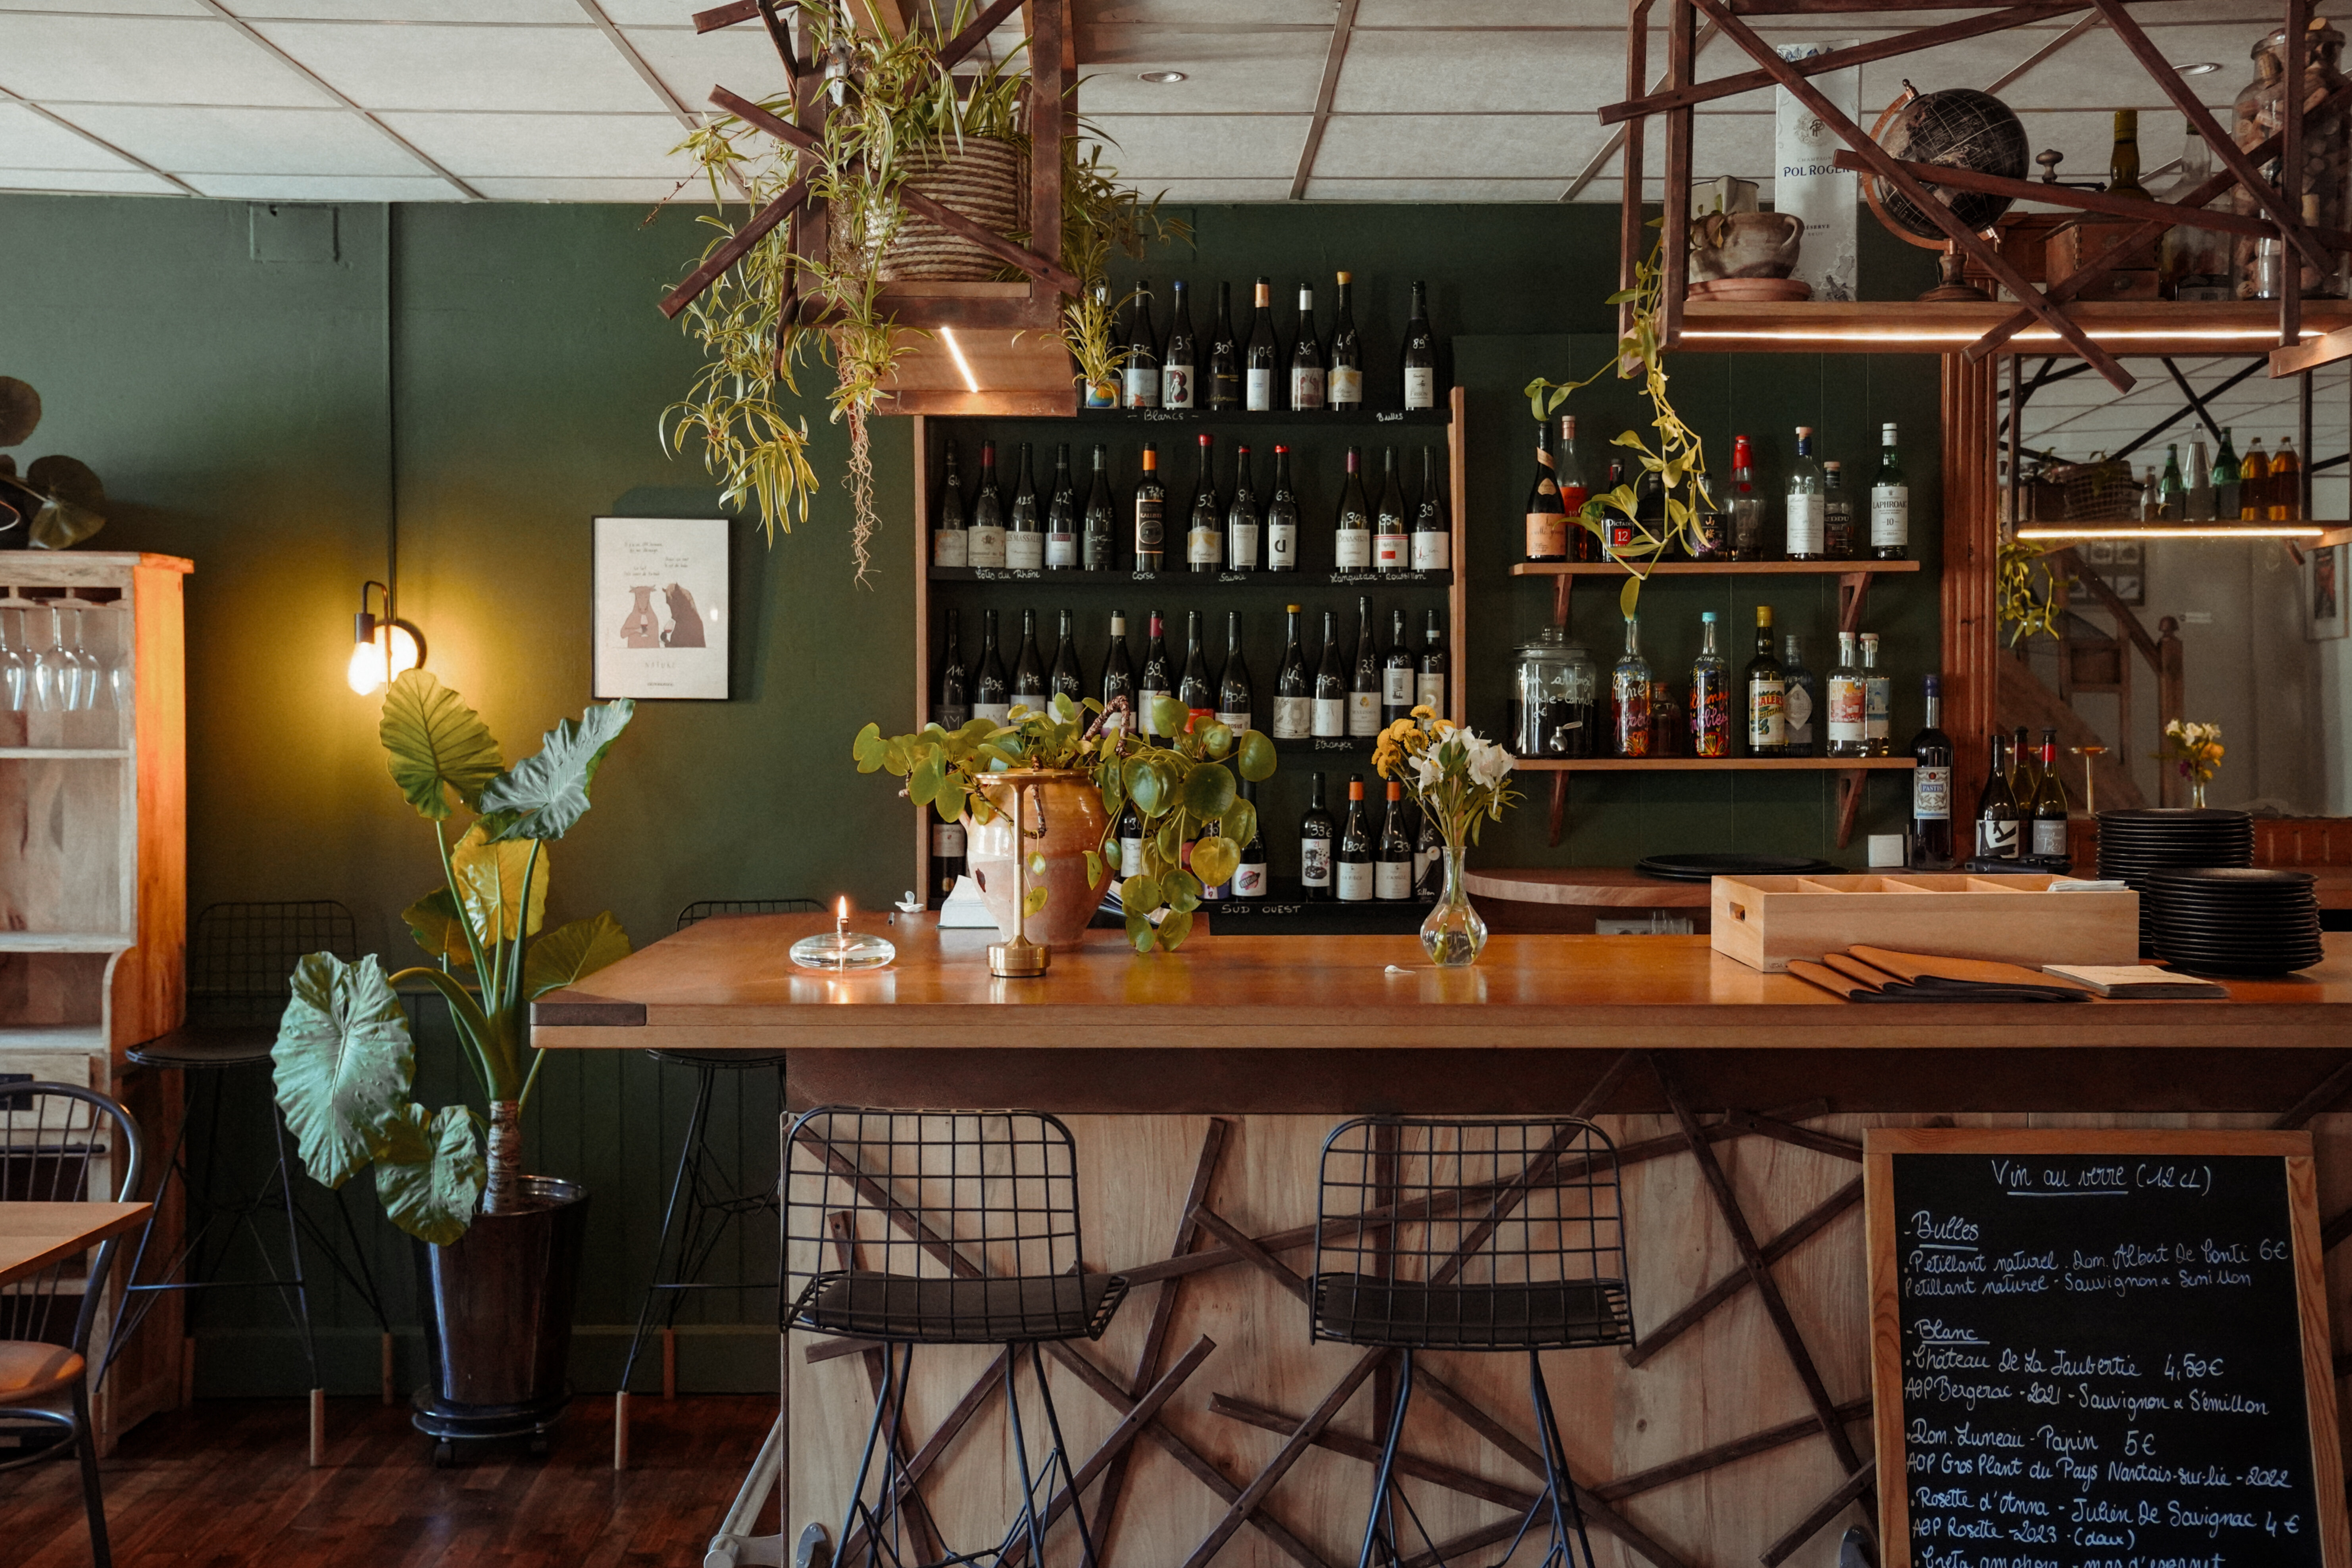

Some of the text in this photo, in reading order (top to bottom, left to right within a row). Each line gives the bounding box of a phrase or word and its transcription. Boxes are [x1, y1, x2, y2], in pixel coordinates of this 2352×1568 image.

[1784, 167, 1807, 177] POL
[1413, 334, 1429, 349] 89€
[1144, 410, 1184, 421] Blancs
[1376, 412, 1403, 422] Bulles
[1056, 488, 1073, 506] 42€
[1873, 500, 1907, 509] LAPHROAIG
[1618, 531, 1628, 541] 12
[975, 569, 995, 580] Côtes
[1013, 569, 1040, 579] Rhône
[1132, 571, 1155, 580] Corse
[1311, 825, 1333, 837] 33€
[1221, 904, 1301, 914] SUD OUEST
[1992, 1160, 2032, 1187] Vin
[2044, 1169, 2070, 1187] au
[2078, 1166, 2128, 1186] verre
[1911, 1210, 1979, 1241] Bulles
[1994, 1251, 2059, 1272] naturel
[2112, 1243, 2169, 1269] Albert
[2176, 1243, 2195, 1264] De
[1982, 1274, 2049, 1295] naturel
[2065, 1272, 2158, 1297] Sauvignon
[1914, 1319, 1978, 1340] Blanc
[1913, 1344, 1990, 1370] Château
[1998, 1348, 2020, 1372] De
[2025, 1348, 2048, 1373] La
[2051, 1349, 2142, 1377] Jaubertie
[1905, 1376, 1933, 1401] AOP
[1934, 1375, 2012, 1411] Bergerac
[2079, 1382, 2170, 1422] Sauvignon
[2037, 1424, 2098, 1458] Papin
[1906, 1451, 1936, 1474] AOP
[1941, 1452, 1973, 1475] Gros
[1978, 1453, 2023, 1477] Plant
[2029, 1460, 2054, 1480] du
[2056, 1456, 2098, 1493] Pays
[1916, 1486, 1975, 1508] Rosette
[2071, 1498, 2133, 1524] Julien
[2138, 1500, 2161, 1526] De
[2167, 1500, 2258, 1539] Savignac
[1913, 1517, 1941, 1539] AOP
[1948, 1516, 2005, 1540] Rosette
